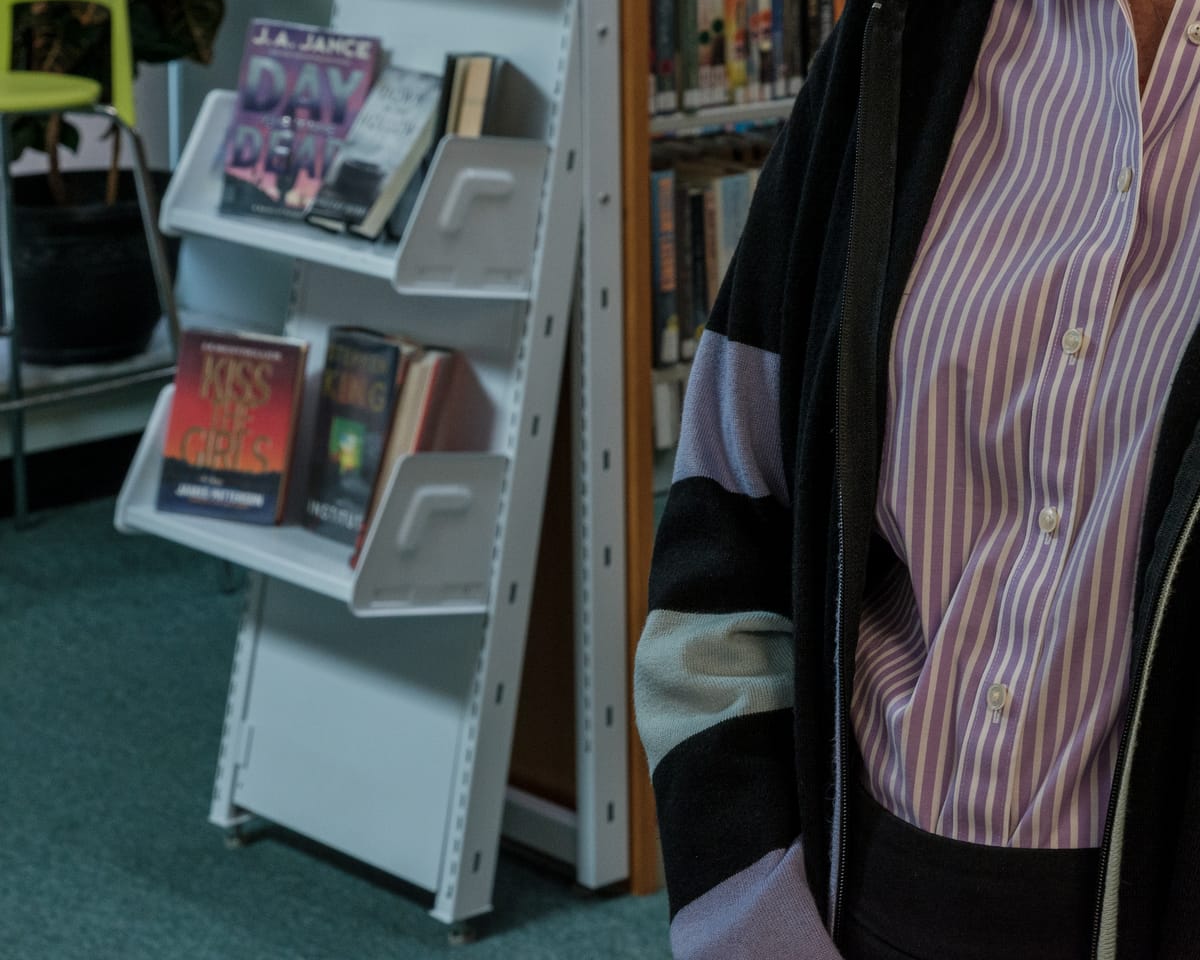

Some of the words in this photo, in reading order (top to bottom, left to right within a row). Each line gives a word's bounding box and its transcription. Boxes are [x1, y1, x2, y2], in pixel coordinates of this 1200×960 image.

[252, 26, 293, 49] J.A.
[299, 34, 373, 59] JANCE
[242, 55, 365, 124] DAY
[201, 355, 273, 408] KISS
[180, 423, 273, 472] GIRLS
